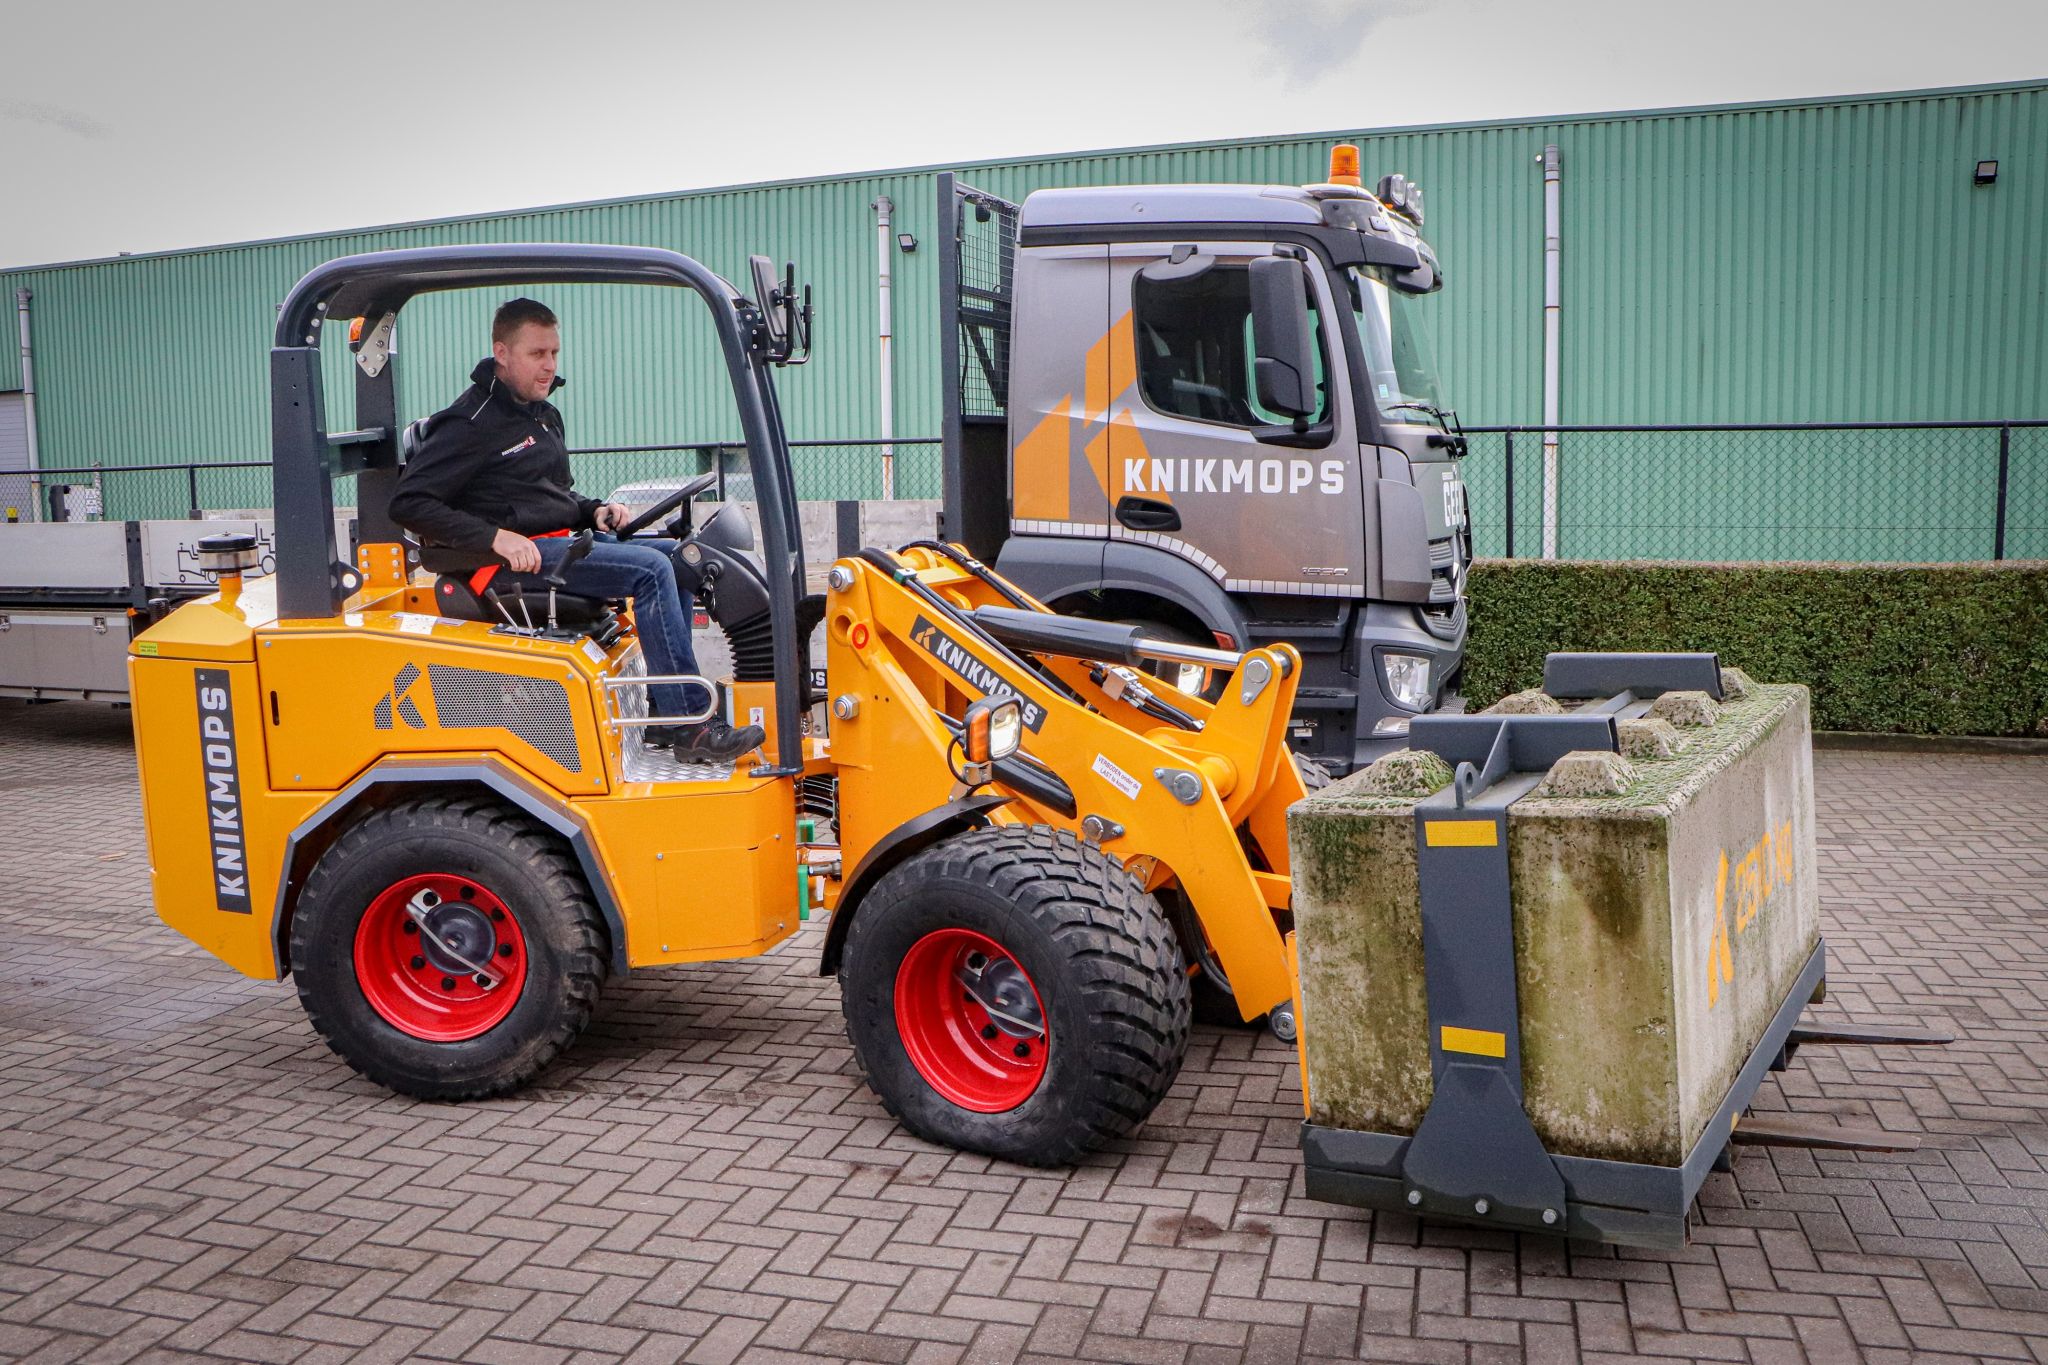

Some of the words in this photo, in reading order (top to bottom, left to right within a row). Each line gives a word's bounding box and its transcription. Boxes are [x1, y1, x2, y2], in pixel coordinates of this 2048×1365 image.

[1124, 458, 1345, 495] KNIKMOPS
[1099, 756, 1121, 776] VERBODEN
[1100, 768, 1111, 778] LAST
[201, 687, 246, 897] KNIKMOPS
